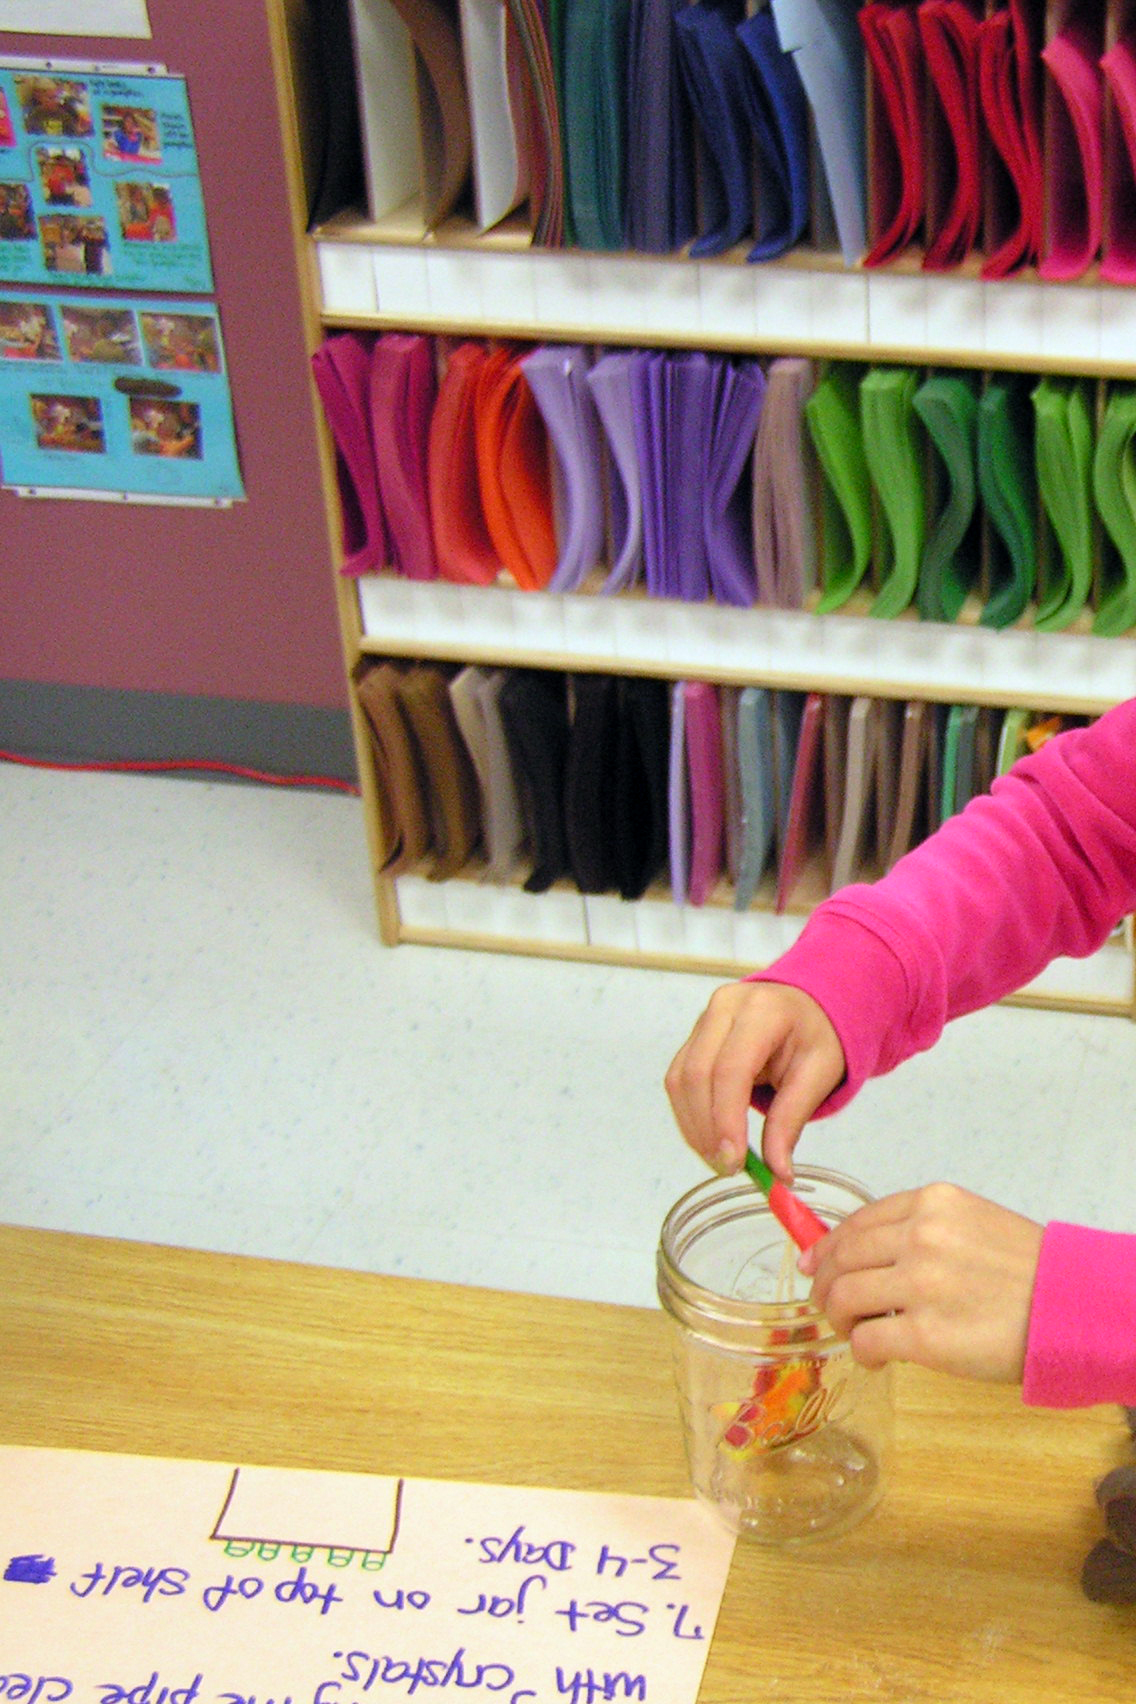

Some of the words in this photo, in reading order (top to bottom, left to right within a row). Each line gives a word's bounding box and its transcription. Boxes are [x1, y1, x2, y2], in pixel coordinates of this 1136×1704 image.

[464, 1525, 577, 1572] Days.
[595, 1543, 682, 1581] 3-4
[202, 1574, 265, 1612] of
[274, 1566, 345, 1616] top
[372, 1588, 432, 1611] on
[456, 1574, 548, 1625] jar
[554, 1599, 650, 1637] Set
[665, 1601, 706, 1641] 7.
[332, 1647, 515, 1696] crystals.
[555, 1665, 647, 1704] with
